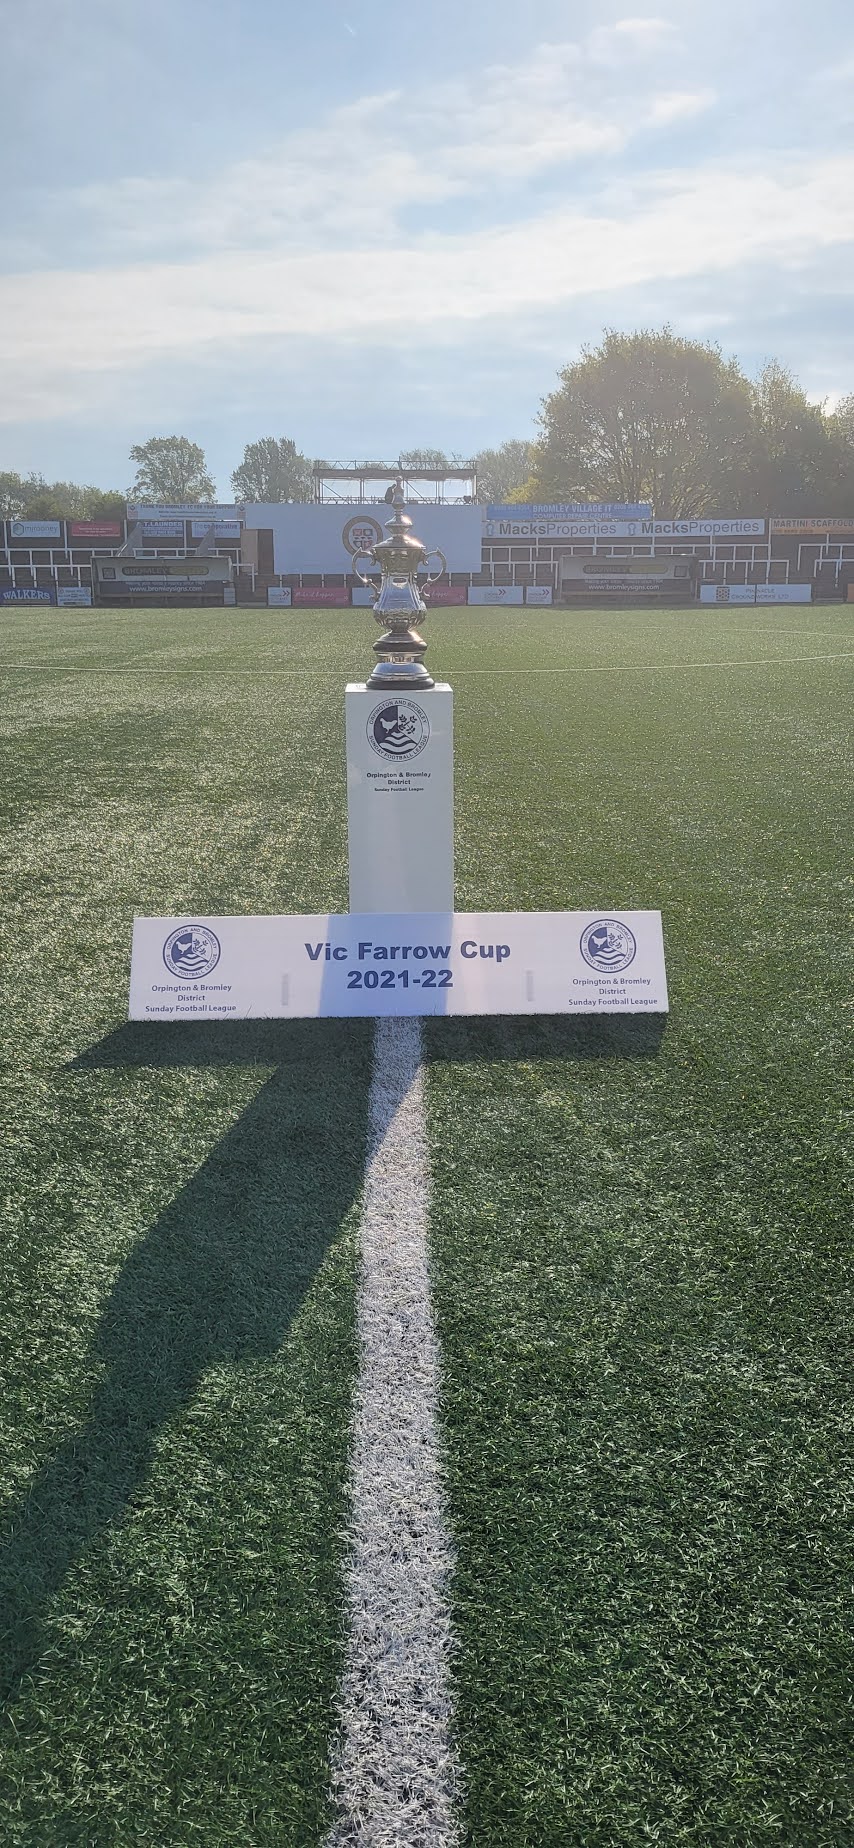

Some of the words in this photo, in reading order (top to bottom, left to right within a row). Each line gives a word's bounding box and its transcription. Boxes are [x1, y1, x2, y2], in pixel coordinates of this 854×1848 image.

[533, 505, 569, 513] BROMLEY
[572, 505, 602, 513] VILLAGE
[499, 522, 616, 536] MacksProperties
[641, 520, 759, 535] MacksProperties
[3, 590, 50, 600] WALKERS
[370, 700, 393, 725] ORPINGTON
[407, 702, 427, 724] BROMLEY
[369, 735, 384, 757] SUNDAY
[413, 735, 428, 755] LEAGUE
[304, 943, 348, 960] Vic
[358, 942, 451, 960] Farrow
[460, 941, 511, 962] Cup
[347, 970, 453, 989] 2021-22
[572, 978, 611, 986] Orpington
[620, 978, 651, 986] Bromley
[151, 984, 191, 992] Orpington
[200, 984, 232, 992] Bromley
[630, 998, 658, 1006] League
[145, 1005, 174, 1013] Sunday
